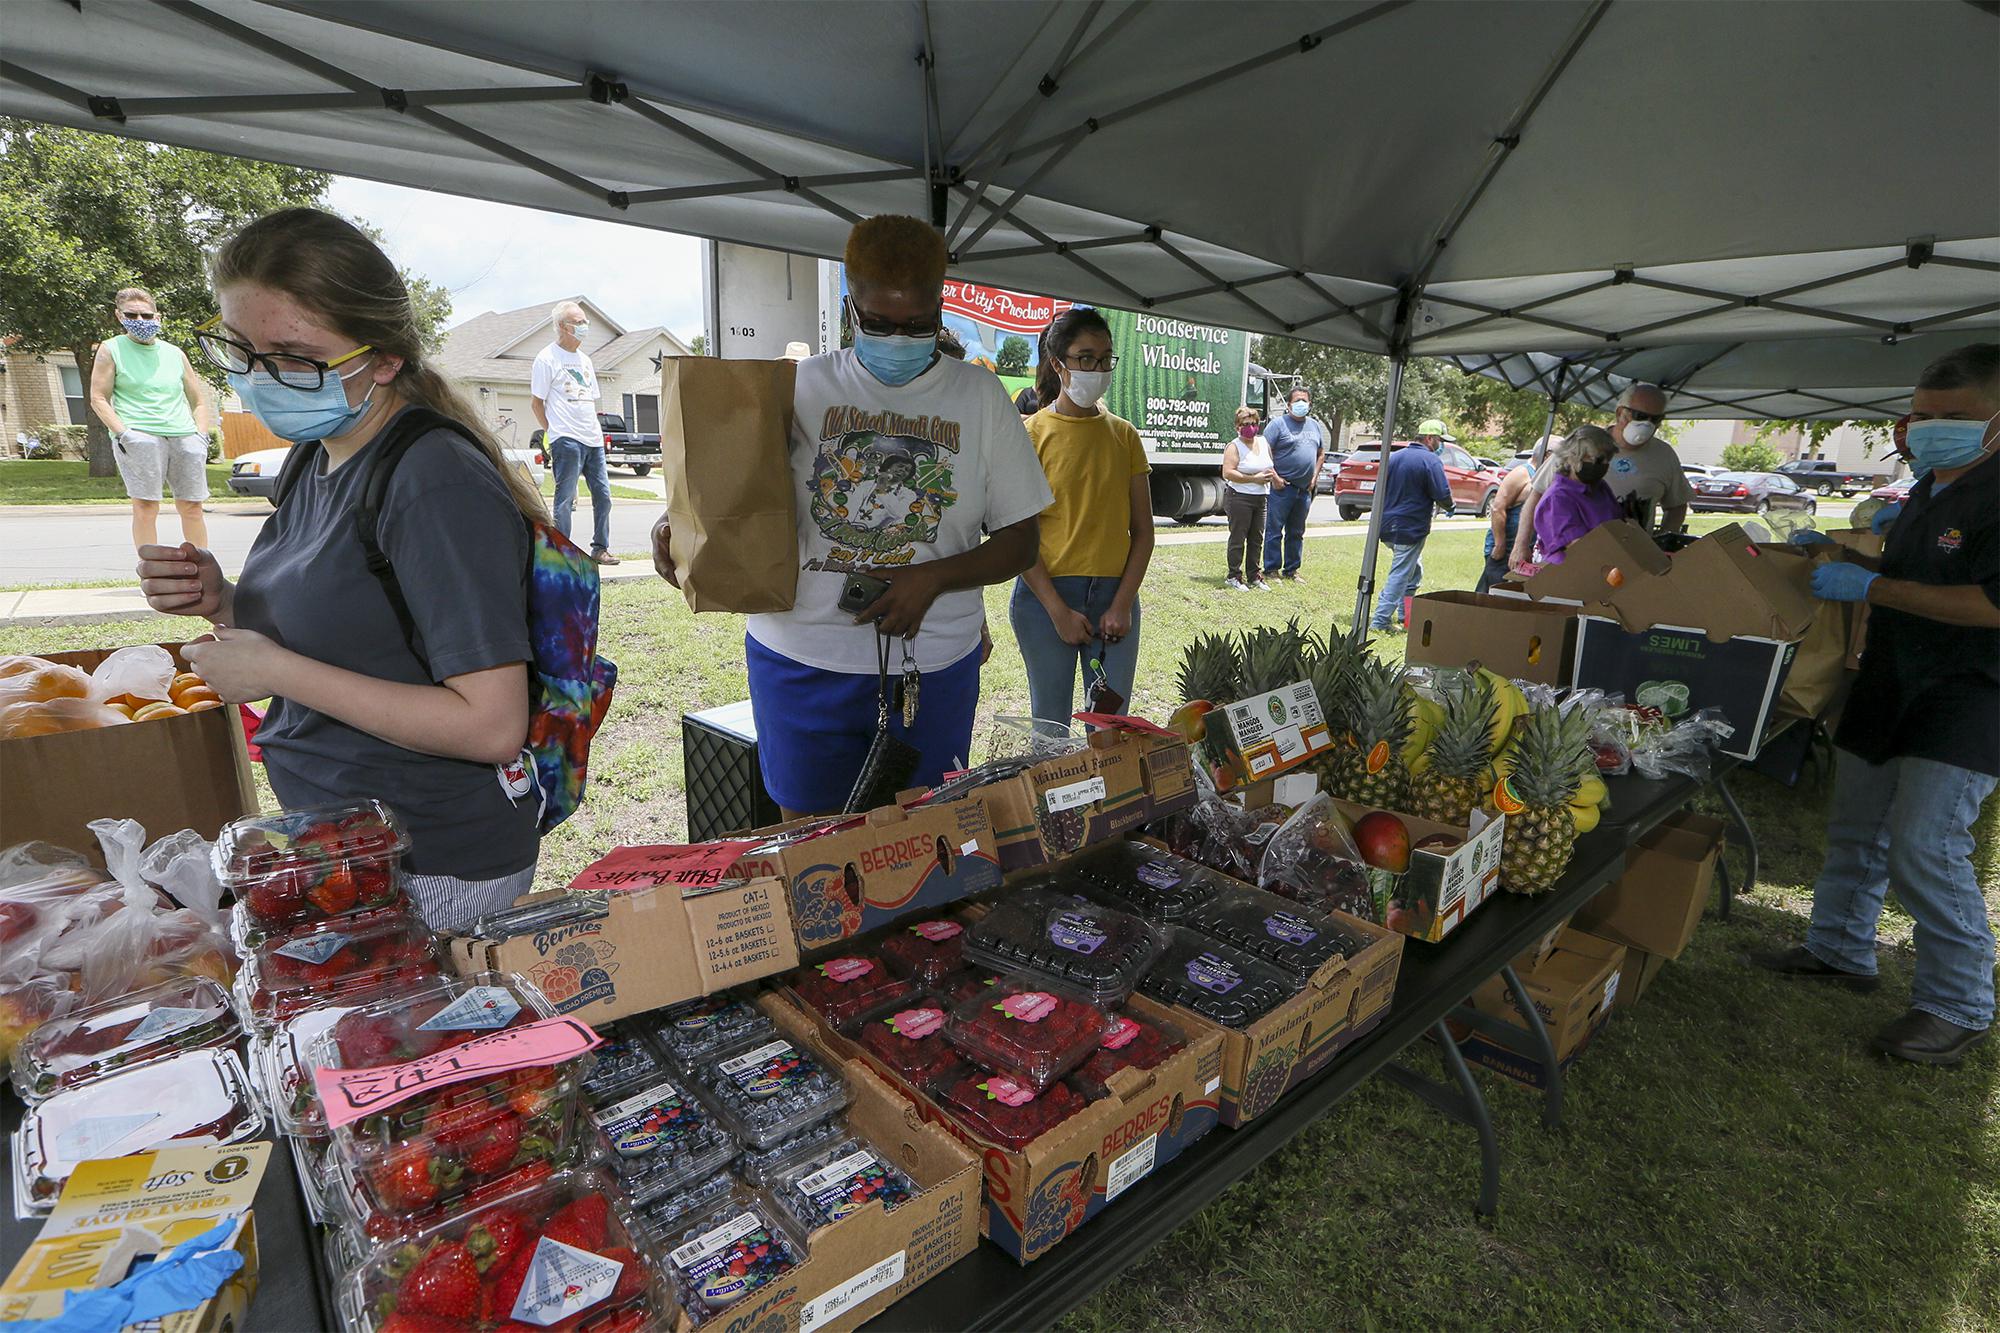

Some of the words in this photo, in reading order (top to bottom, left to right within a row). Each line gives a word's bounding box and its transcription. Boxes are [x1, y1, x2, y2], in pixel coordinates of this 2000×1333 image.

[961, 283, 994, 313] City
[994, 294, 1050, 320] Produce
[1136, 313, 1229, 345] Foodservice
[1142, 344, 1221, 375] Wholesale
[1146, 397, 1210, 414] 800-792-0071
[820, 406, 845, 441] Old
[848, 405, 887, 436] School
[1146, 412, 1208, 428] 210-271-0164
[1650, 634, 1700, 651] LIMES
[1237, 717, 1260, 729] MANGOS
[1032, 761, 1088, 786] Mainland
[1092, 753, 1122, 771] Farms
[1110, 810, 1144, 830] Blackberries
[860, 833, 934, 874] BERRIES
[743, 889, 768, 904] CAT-1
[718, 910, 741, 920] PRODUCT
[751, 902, 770, 912] MEXICO
[752, 912, 772, 923] MEXICO
[533, 922, 602, 956] Berries
[706, 937, 723, 949] 12-6
[735, 926, 765, 941] BASKETS
[740, 938, 768, 952] BASKETS
[743, 950, 770, 965] BASKETS
[556, 999, 580, 1013] ALIDAD
[580, 986, 611, 1003] PREMIUM
[1259, 1007, 1310, 1050] Mainland
[1312, 990, 1340, 1015] Farms
[1482, 1055, 1537, 1082] BANANAS
[1102, 1094, 1170, 1160] BERRIES
[225, 1163, 238, 1175] L
[143, 1170, 194, 1192] Soft
[156, 1194, 231, 1217] GREAT
[939, 1191, 964, 1213] CAT-1
[72, 1207, 153, 1228] GLOVE
[924, 1230, 952, 1253] BASKETS
[926, 1241, 952, 1263] BASKETS
[689, 1255, 721, 1274] Bleuets
[723, 1250, 744, 1264] Blue
[926, 1253, 952, 1275] BASKETS
[585, 1267, 616, 1287] GEM
[692, 1262, 725, 1280] Berries
[523, 1294, 560, 1317] PACK
